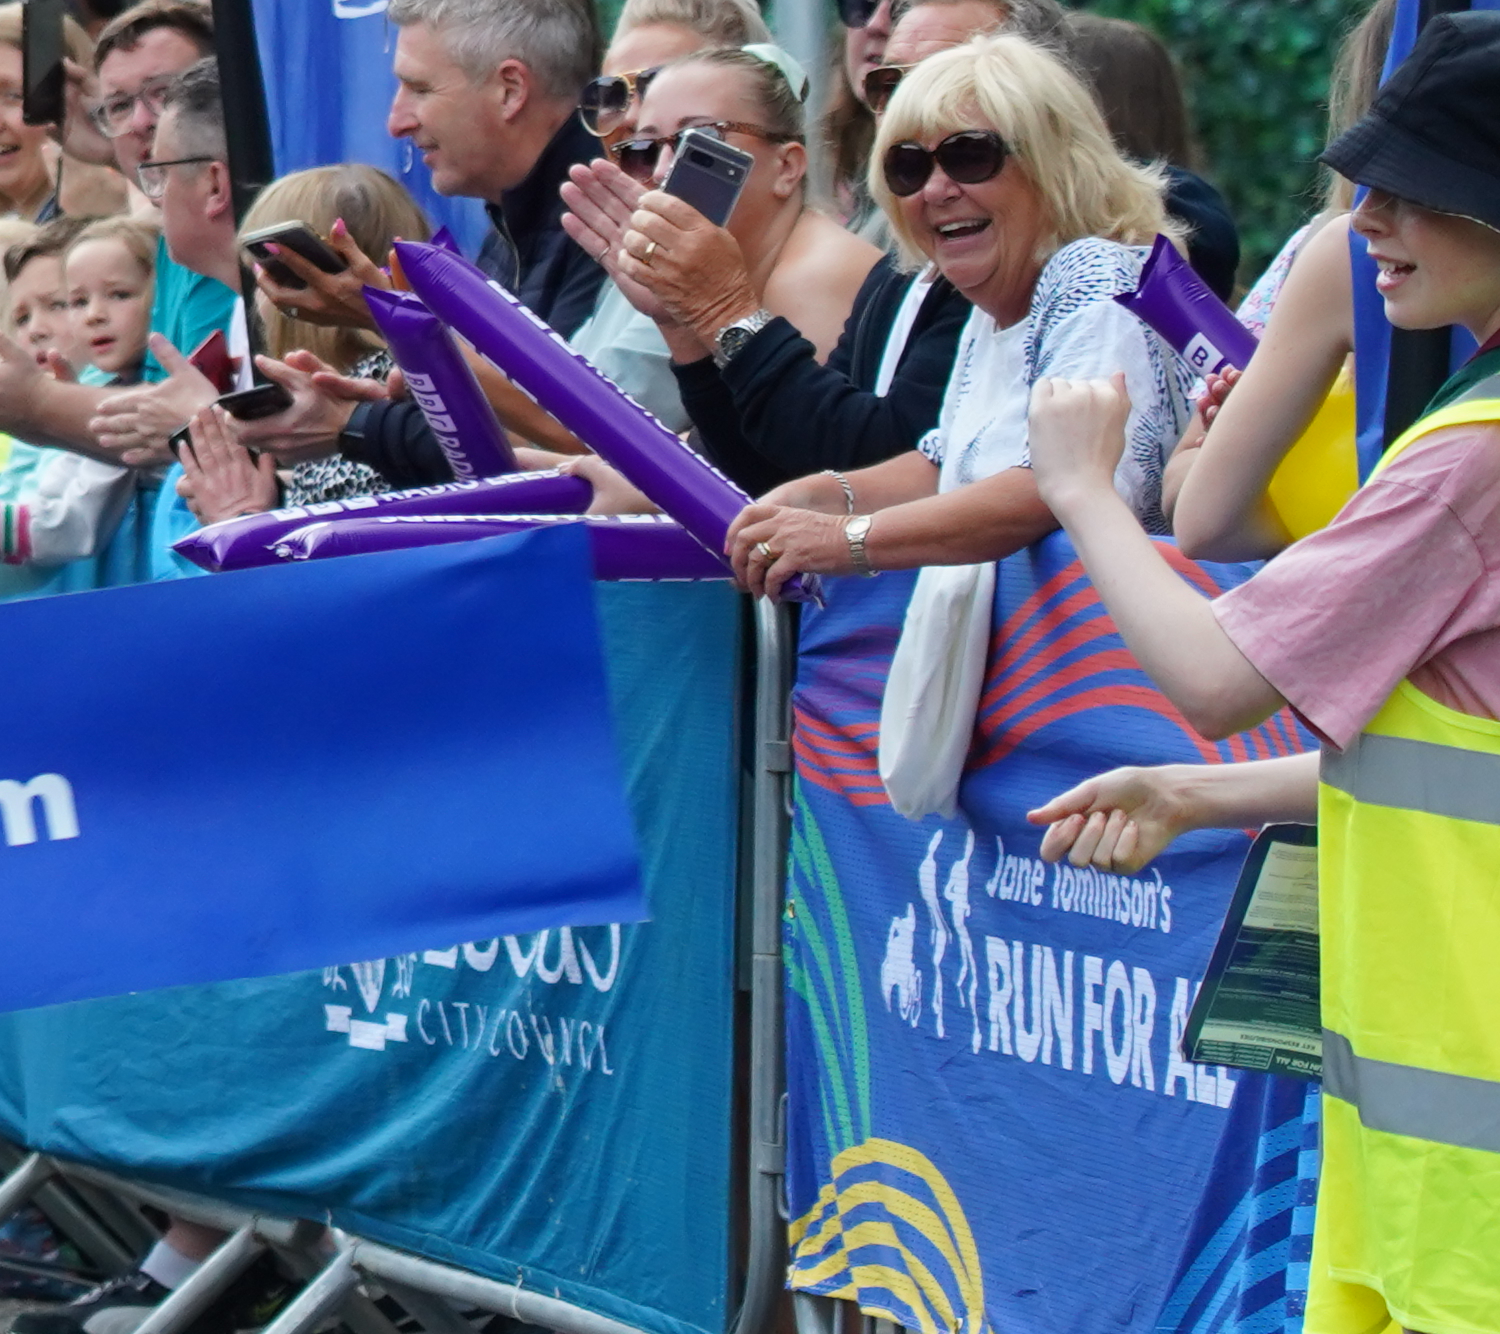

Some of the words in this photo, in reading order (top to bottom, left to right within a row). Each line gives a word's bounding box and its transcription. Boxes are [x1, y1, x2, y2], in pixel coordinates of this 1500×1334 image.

[985, 835, 1045, 907] Jane
[416, 998, 489, 1052] CITY
[985, 935, 1075, 1071] RUN
[1082, 954, 1158, 1092] FOR
